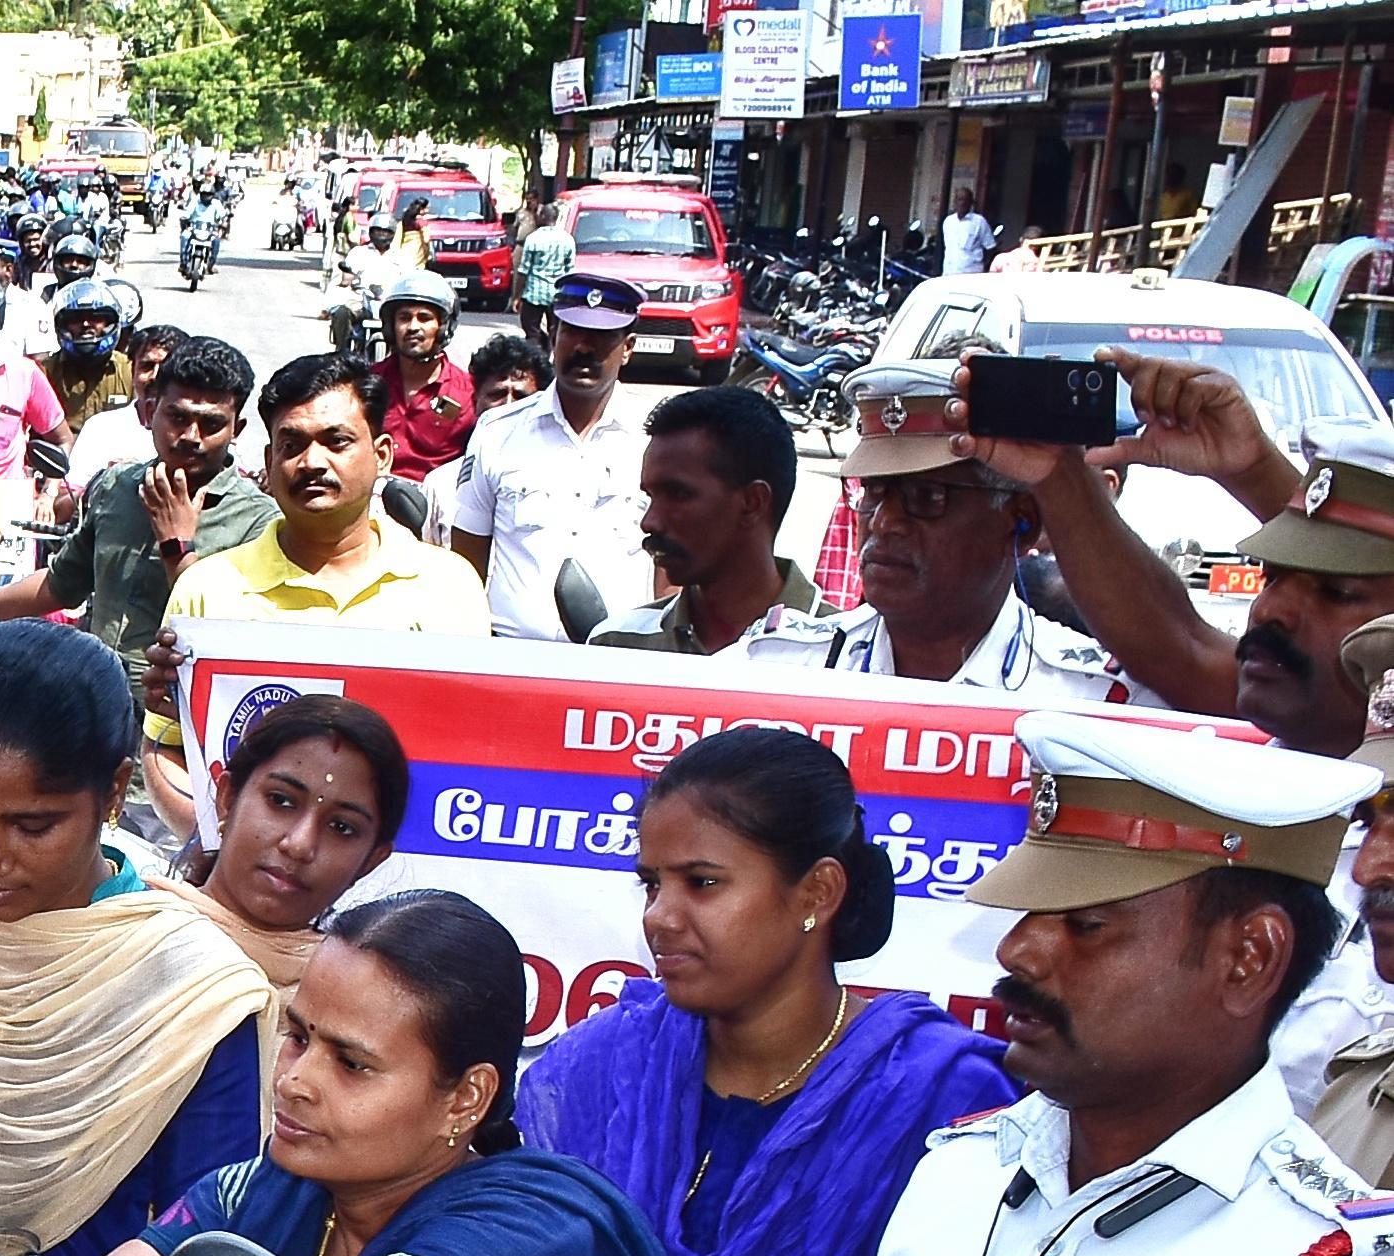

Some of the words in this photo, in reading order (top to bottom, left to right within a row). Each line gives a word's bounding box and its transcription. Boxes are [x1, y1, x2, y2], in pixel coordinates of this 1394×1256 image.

[757, 17, 802, 31] medall
[734, 46, 756, 54] BLOOD
[758, 46, 799, 54] COLLECTION
[753, 57, 779, 65] CENTRE
[861, 63, 899, 77] Bank
[851, 79, 868, 94] of
[870, 79, 908, 94] India
[867, 95, 892, 106] ATM
[1128, 326, 1224, 344] POLICE
[228, 702, 256, 738] TAMIL
[254, 689, 291, 703] NADU
[563, 706, 864, 772] மதுர
